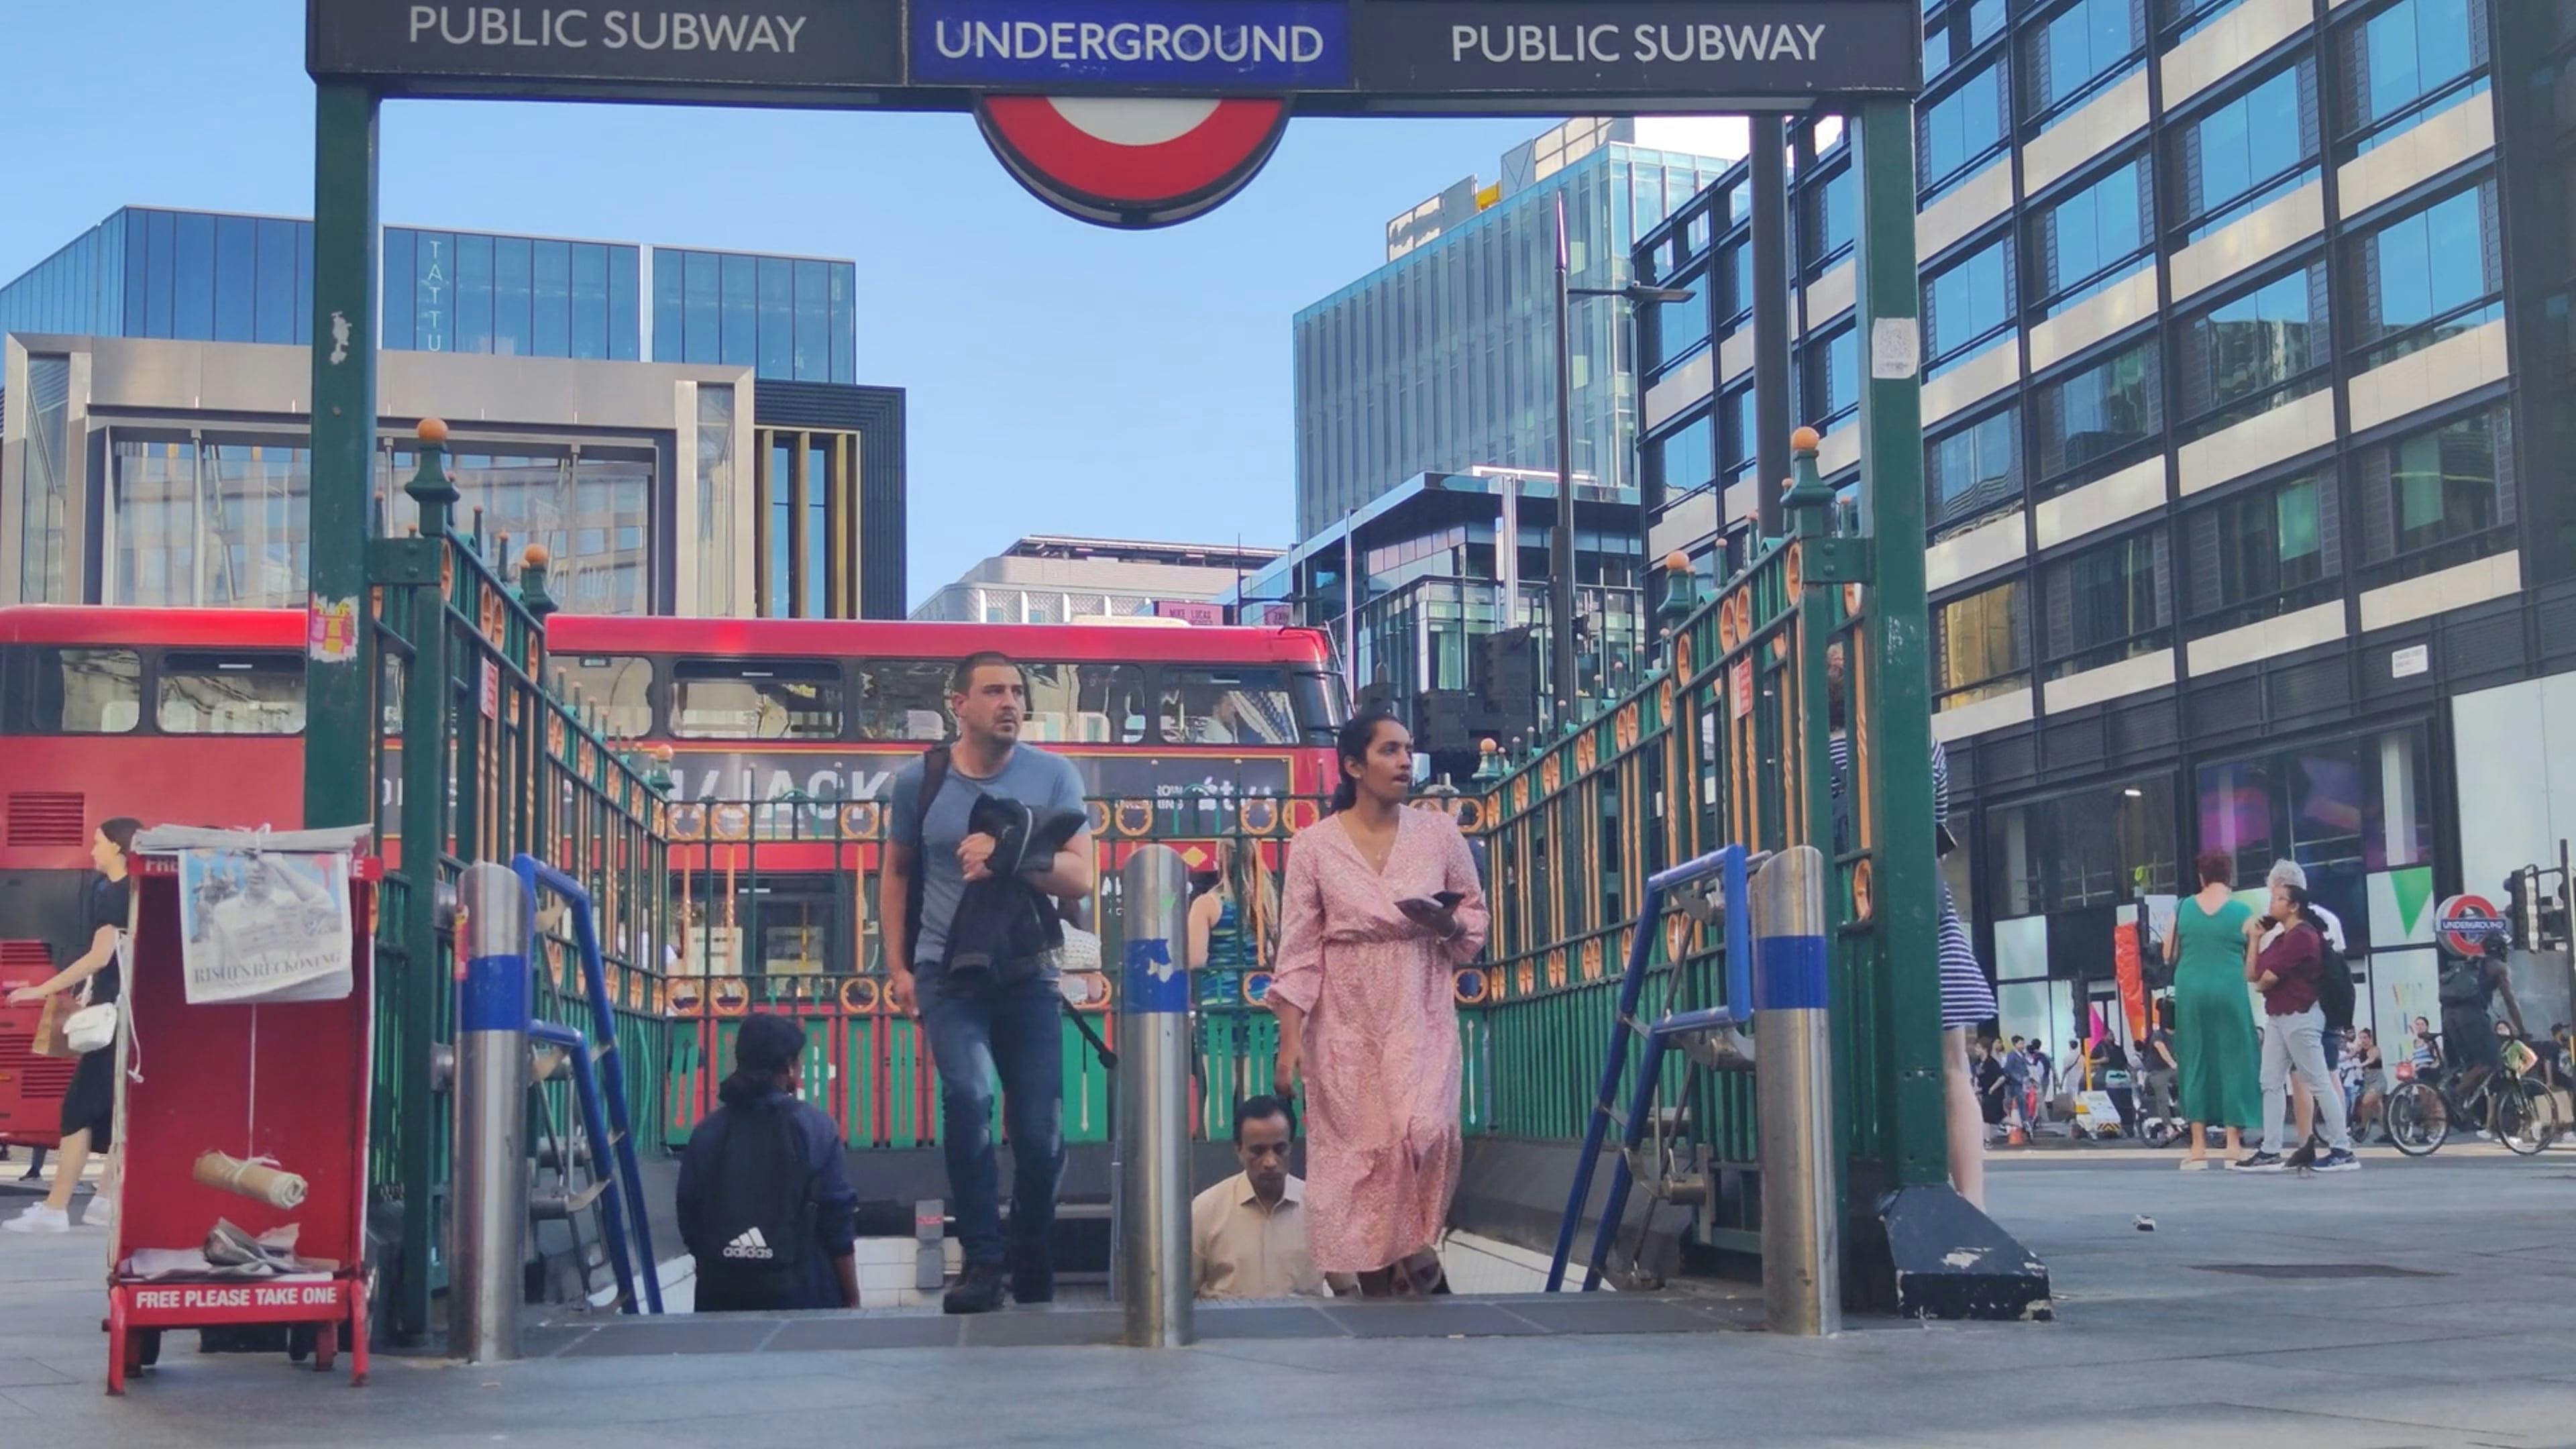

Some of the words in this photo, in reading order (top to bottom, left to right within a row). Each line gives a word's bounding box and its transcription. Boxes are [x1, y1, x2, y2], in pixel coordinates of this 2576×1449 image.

[409, 6, 588, 47] PUBLIC
[602, 11, 807, 53] SUBWAY
[936, 19, 1324, 62] UNDERGROUND
[1452, 24, 1619, 62] PUBLIC
[1633, 24, 1825, 62] SUBWAY
[427, 240, 443, 352] TATTU
[2443, 920, 2504, 929] UNDERGROUND
[723, 1246, 773, 1258] adidas
[136, 1291, 180, 1308] FREE
[184, 1289, 250, 1306] PLEASE
[255, 1287, 298, 1305] TAKE
[303, 1287, 337, 1303] ONE
